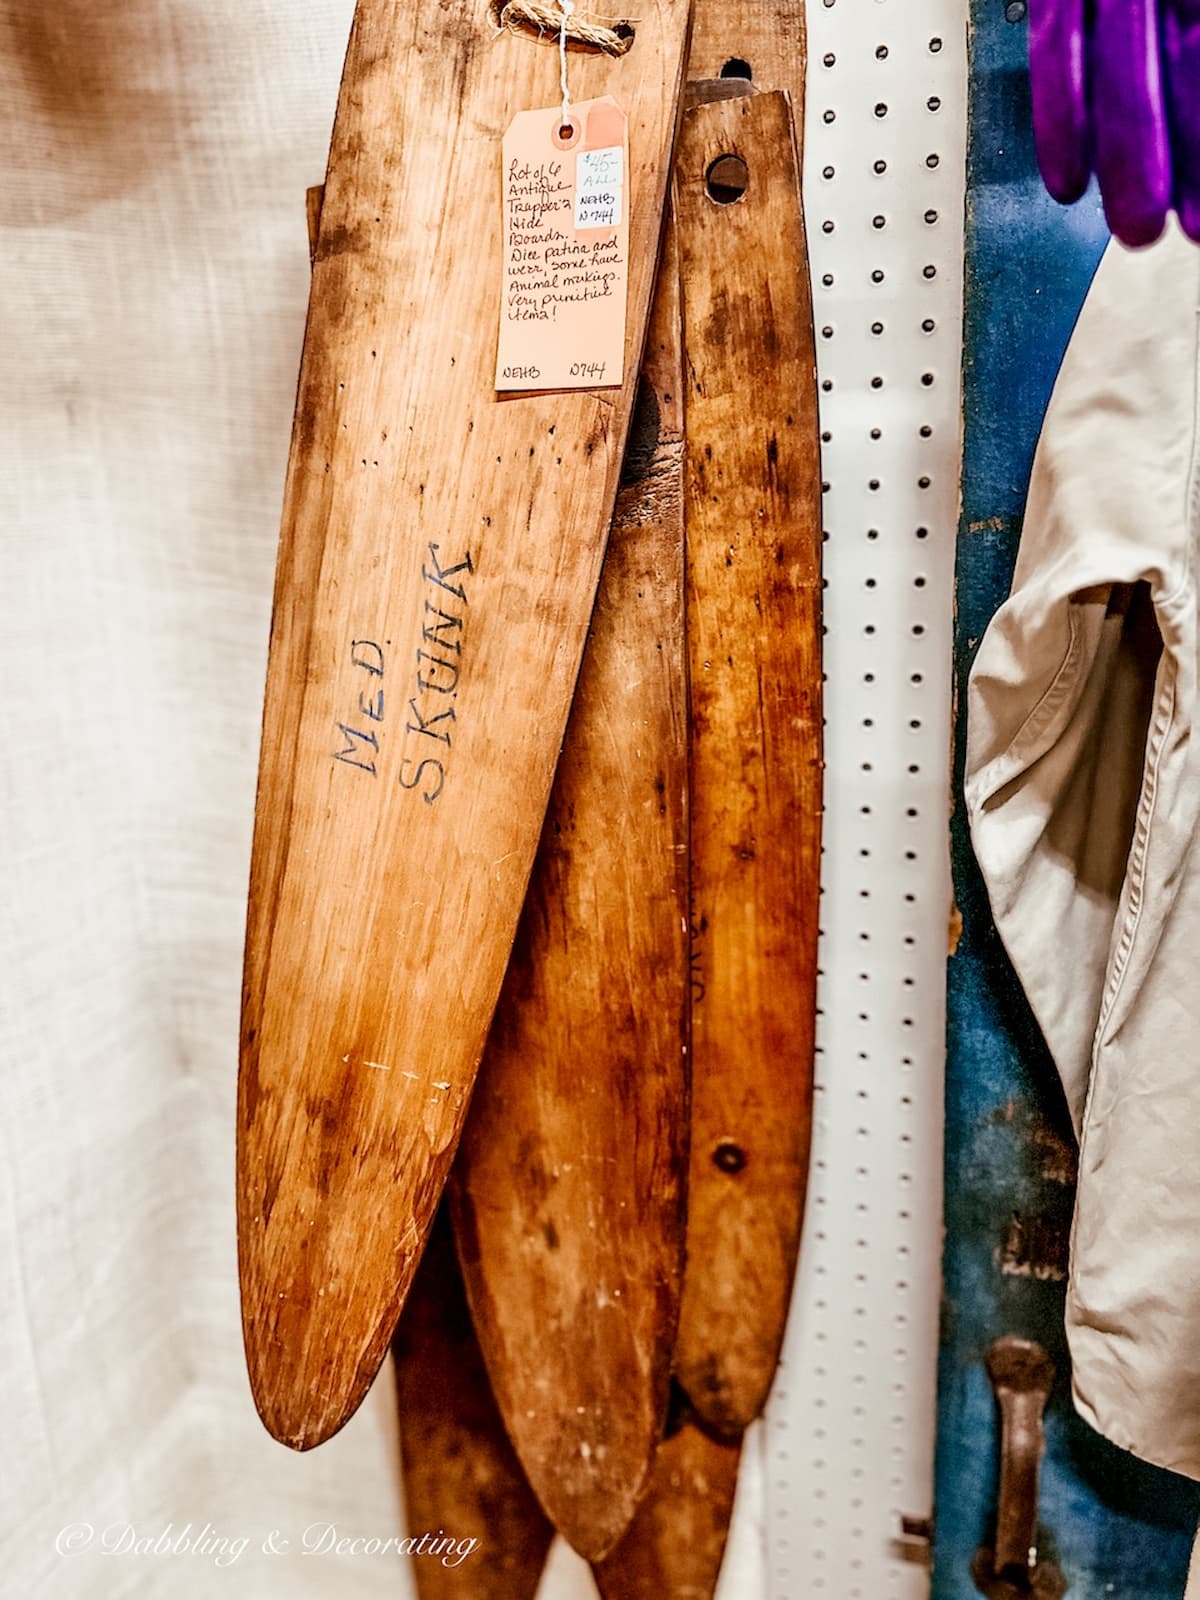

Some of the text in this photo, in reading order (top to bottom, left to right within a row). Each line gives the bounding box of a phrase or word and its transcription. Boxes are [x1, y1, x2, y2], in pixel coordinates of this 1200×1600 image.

[508, 158, 531, 182] Lot
[509, 175, 572, 206] Antique
[509, 217, 544, 231] Hide
[544, 240, 590, 264] patina
[592, 235, 618, 252] and
[551, 259, 587, 271] some
[588, 252, 624, 266] have
[509, 274, 559, 292] Animal
[507, 293, 537, 312] Very
[502, 365, 541, 380] NEHB
[399, 541, 475, 806] SKUNK
